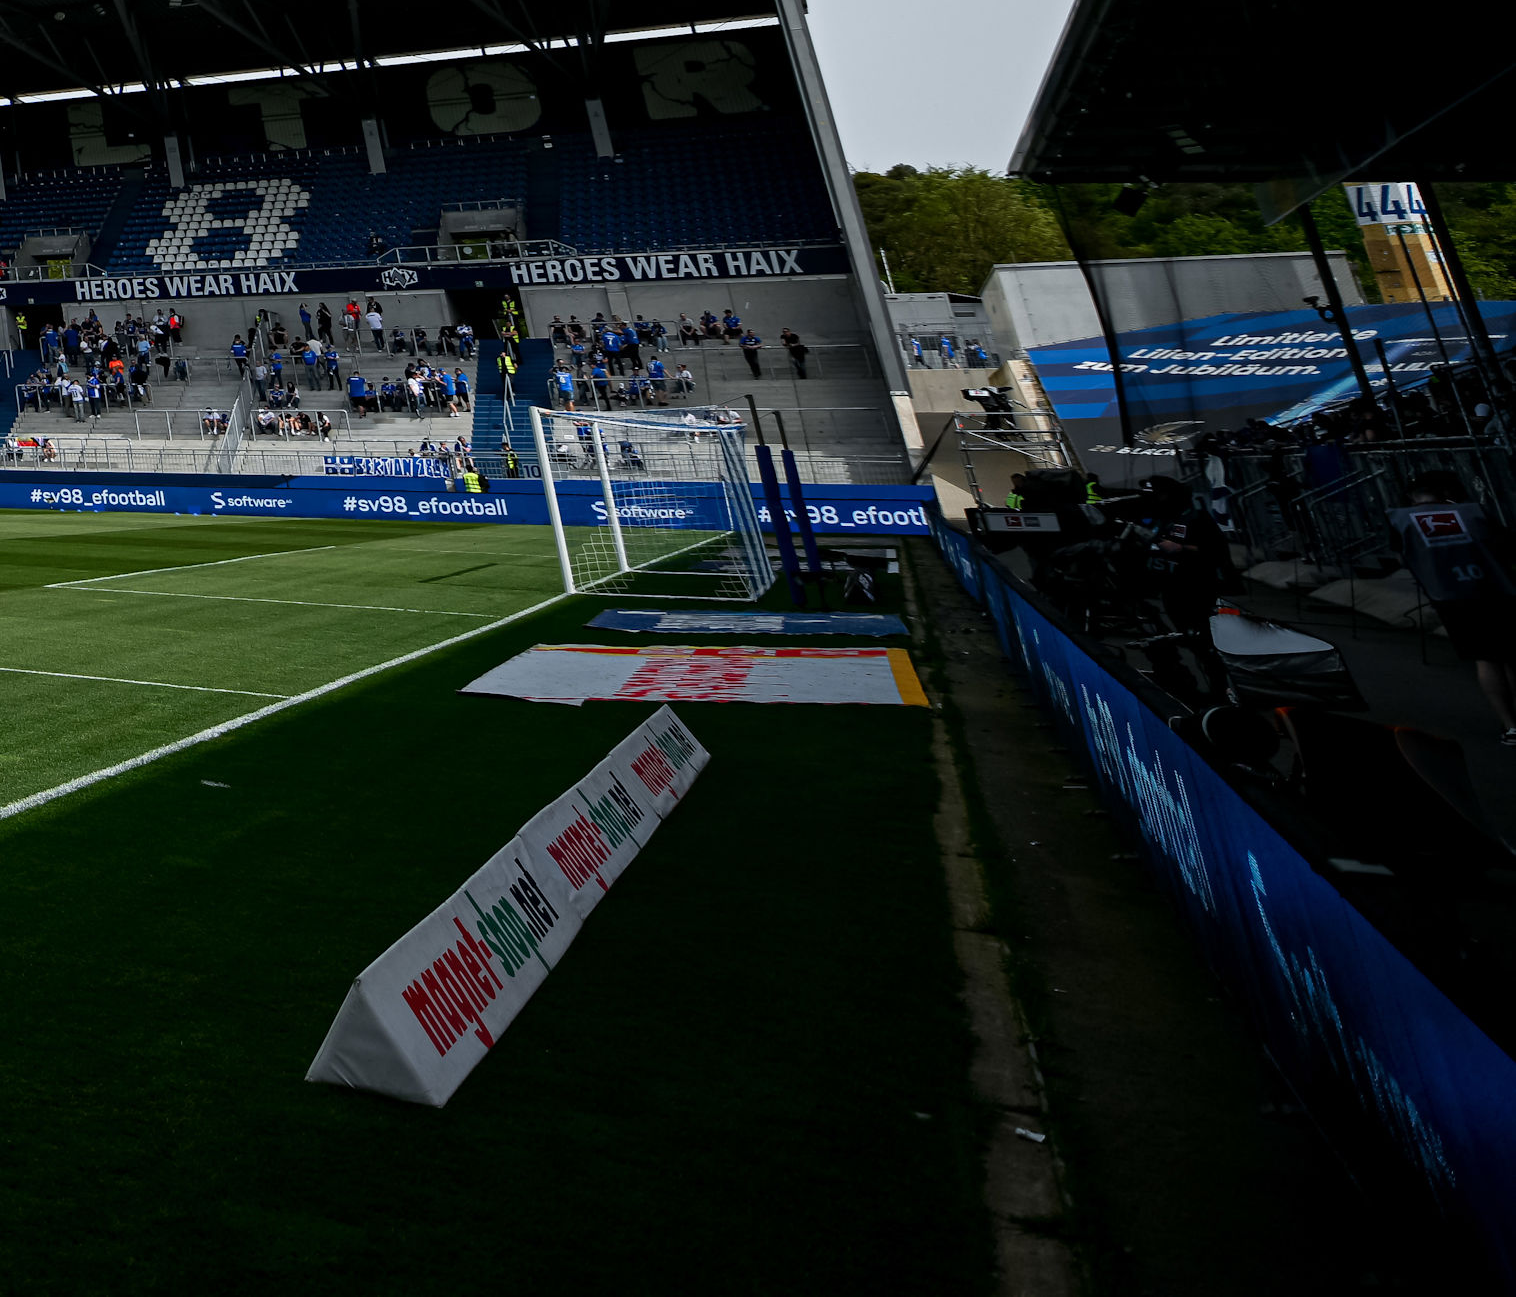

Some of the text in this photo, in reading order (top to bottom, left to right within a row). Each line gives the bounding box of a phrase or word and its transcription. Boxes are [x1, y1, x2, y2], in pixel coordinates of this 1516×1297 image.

[511, 249, 804, 284] HEROES WEAR HAIX
[75, 271, 299, 300] HEROES WEAR HAIX
[1209, 329, 1380, 347] Limitiere
[1126, 346, 1349, 362] Lilien-Edition
[1149, 361, 1322, 376] Jubiläum.
[524, 465, 541, 478] 10
[228, 497, 286, 508] software
[344, 496, 507, 515] #sv98_efootball
[613, 505, 685, 520] software
[630, 714, 698, 799] magnet-shop.net
[545, 770, 643, 893] magnet-shop.net
[400, 856, 560, 1057] magnet-shop.net
